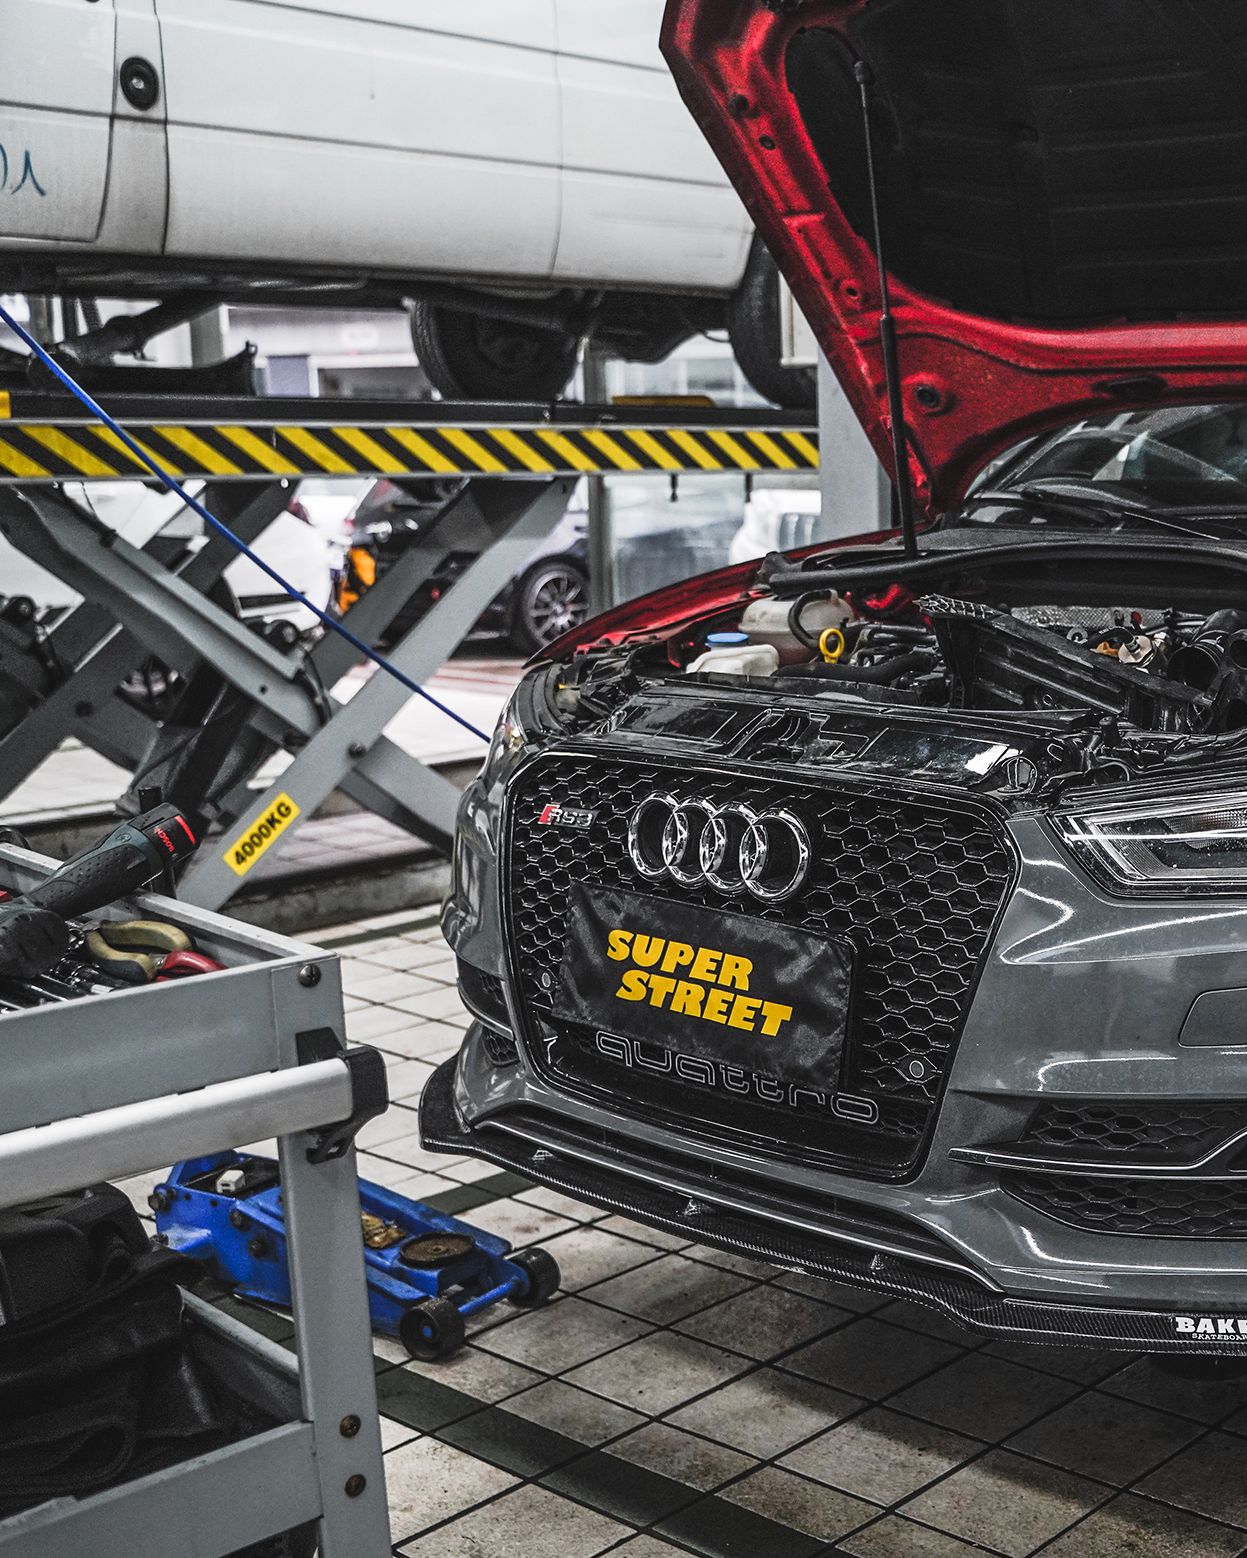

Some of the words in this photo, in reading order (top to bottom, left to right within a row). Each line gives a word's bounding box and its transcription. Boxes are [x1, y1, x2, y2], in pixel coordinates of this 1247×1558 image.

[234, 802, 292, 866] 4000KG
[543, 806, 594, 827] RS3
[606, 928, 754, 992] SUPER
[615, 969, 794, 1038] STREET
[595, 1029, 880, 1125] quattro
